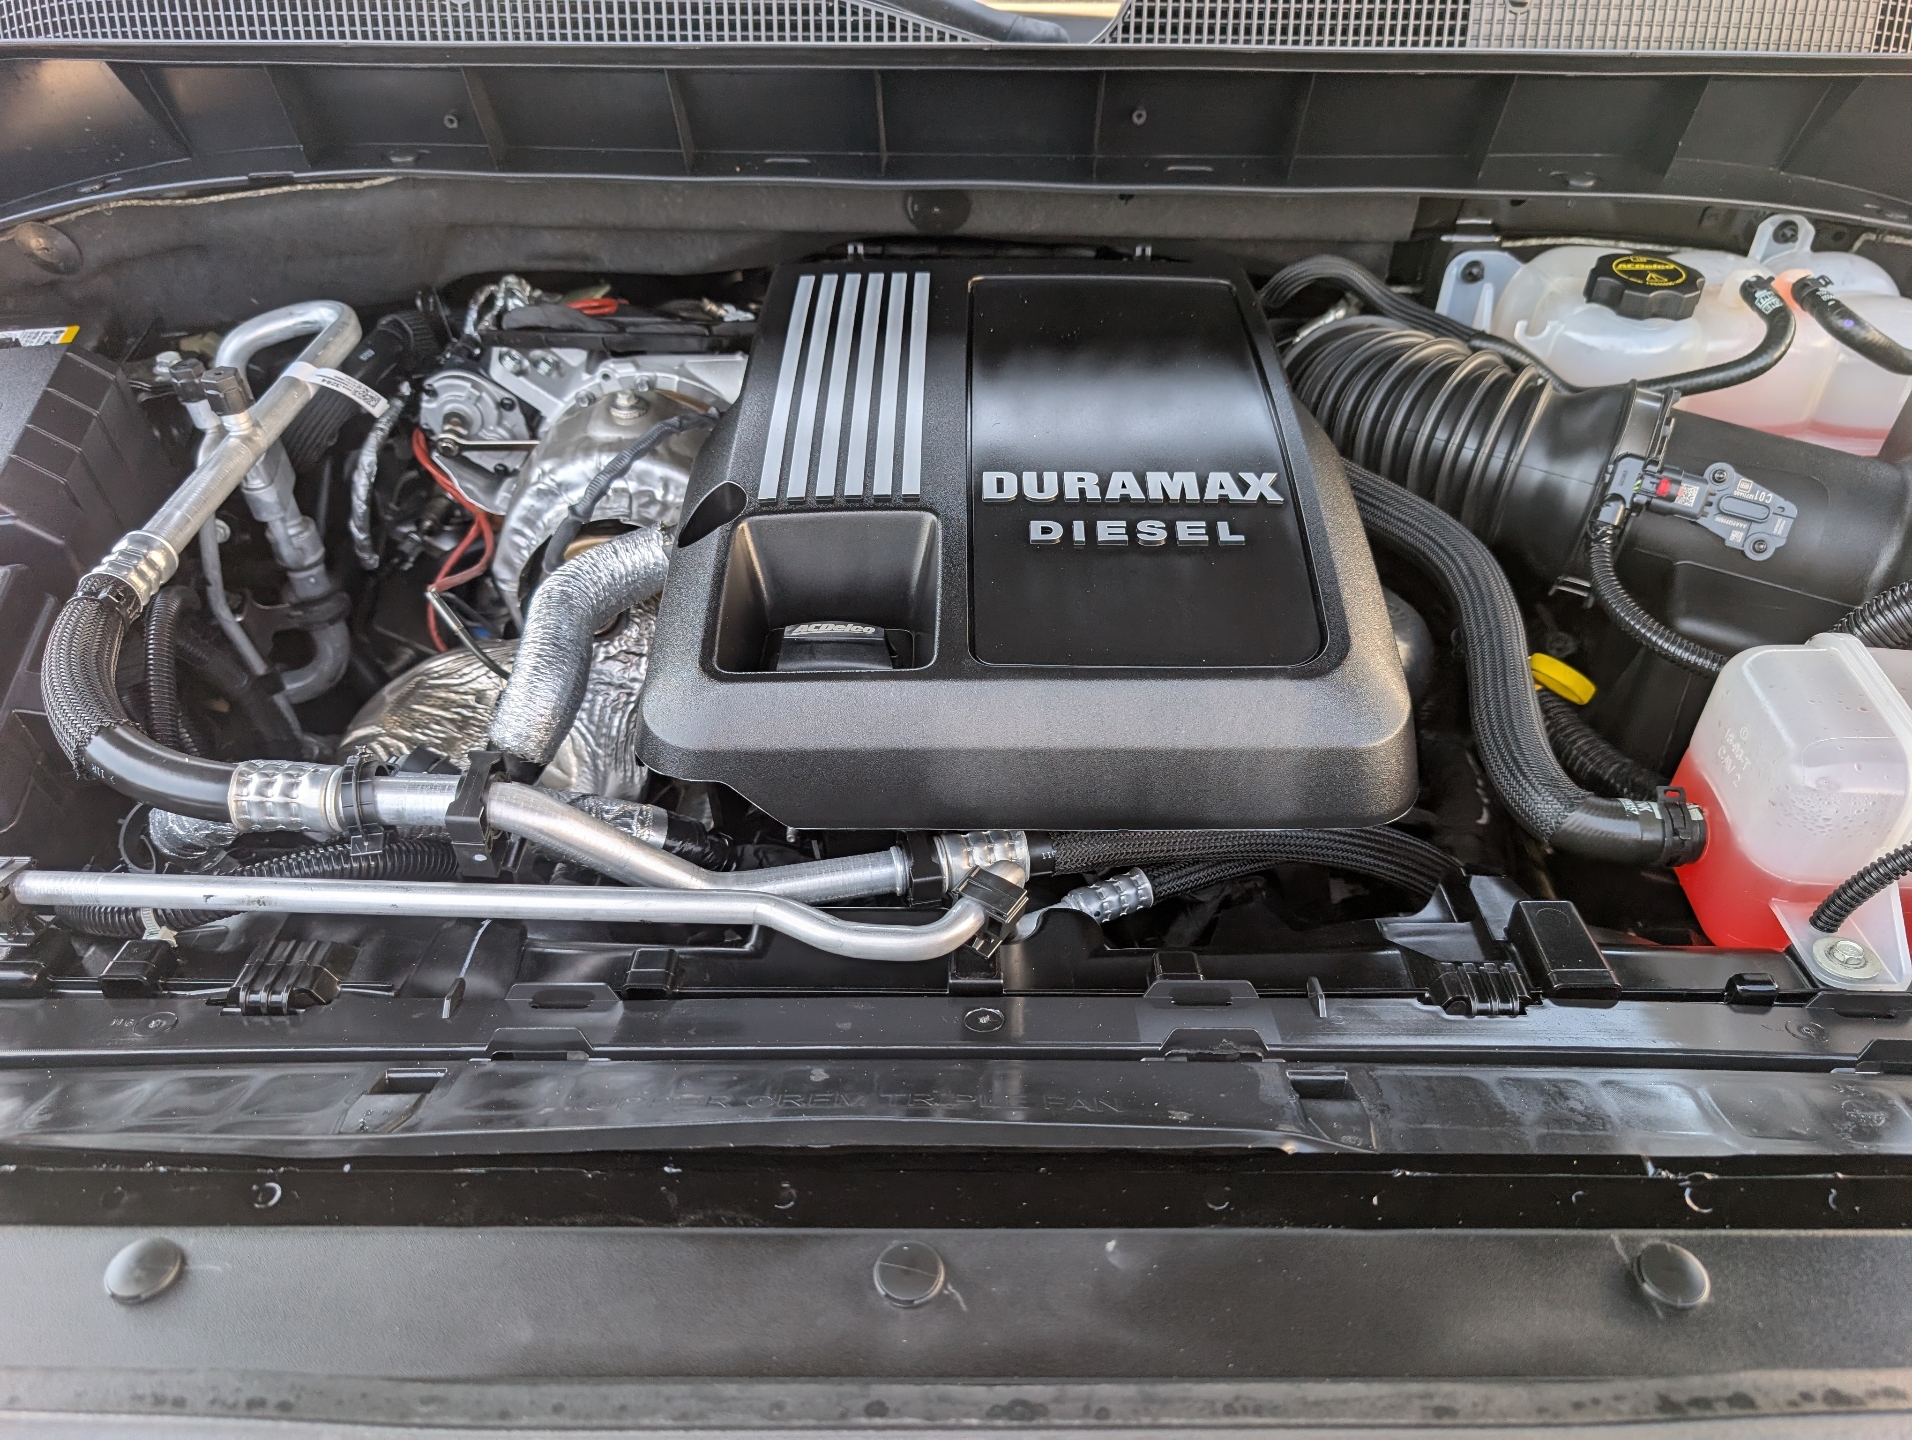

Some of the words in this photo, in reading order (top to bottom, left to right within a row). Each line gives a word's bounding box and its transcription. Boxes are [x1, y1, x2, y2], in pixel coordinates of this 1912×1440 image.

[982, 471, 1284, 504] DURAMAX
[1029, 520, 1246, 546] DIESEL
[791, 623, 876, 635] ACDelco
[1044, 1095, 1124, 1113] FAN
